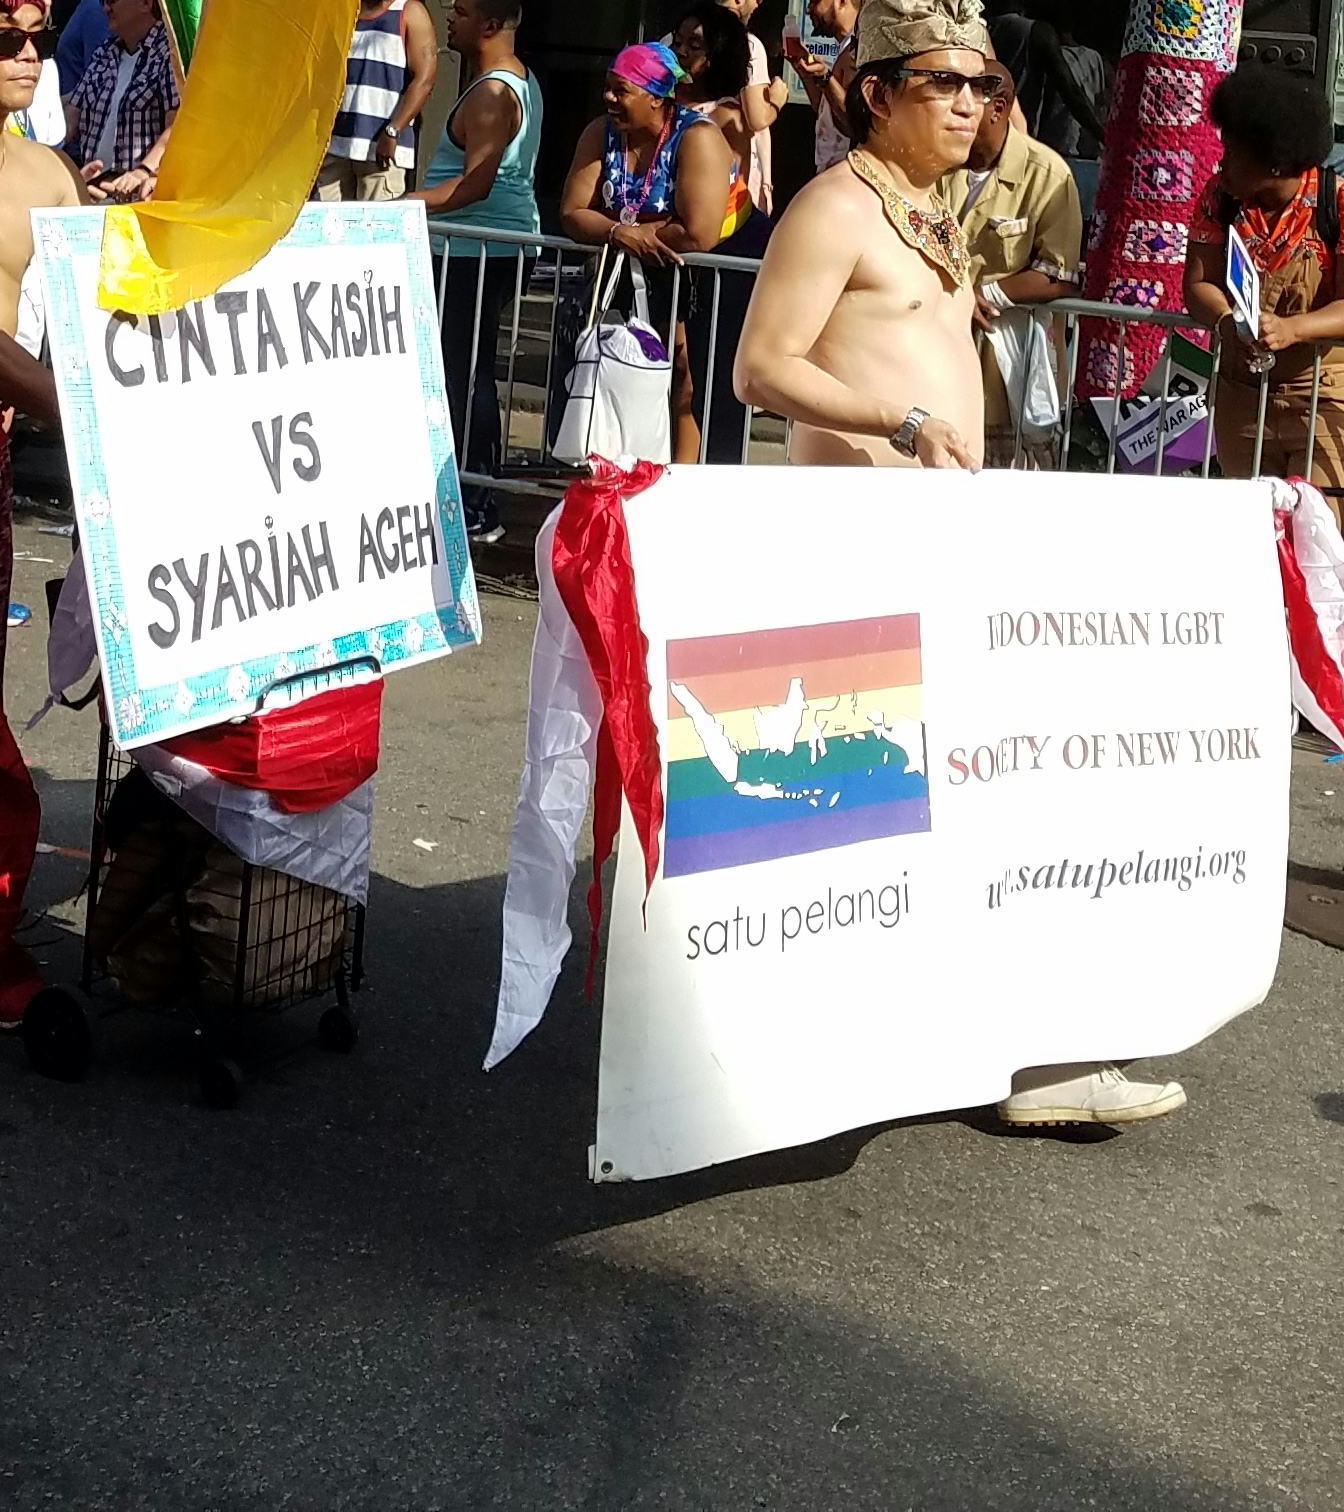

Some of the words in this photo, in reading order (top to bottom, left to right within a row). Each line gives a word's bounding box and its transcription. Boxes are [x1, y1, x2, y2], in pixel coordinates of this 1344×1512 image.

[104, 288, 289, 387] CINTA
[293, 271, 407, 364] KASIH
[252, 412, 322, 494] VS
[1129, 431, 1156, 454] THE
[147, 516, 340, 650] SYARIAH
[1160, 611, 1224, 645] LGBT
[947, 735, 1052, 785] SOETY
[1062, 734, 1106, 769] OF
[1116, 731, 1180, 767] NEW
[1188, 727, 1261, 763] YORK
[686, 905, 766, 960] satu
[781, 871, 909, 953] pelangi
